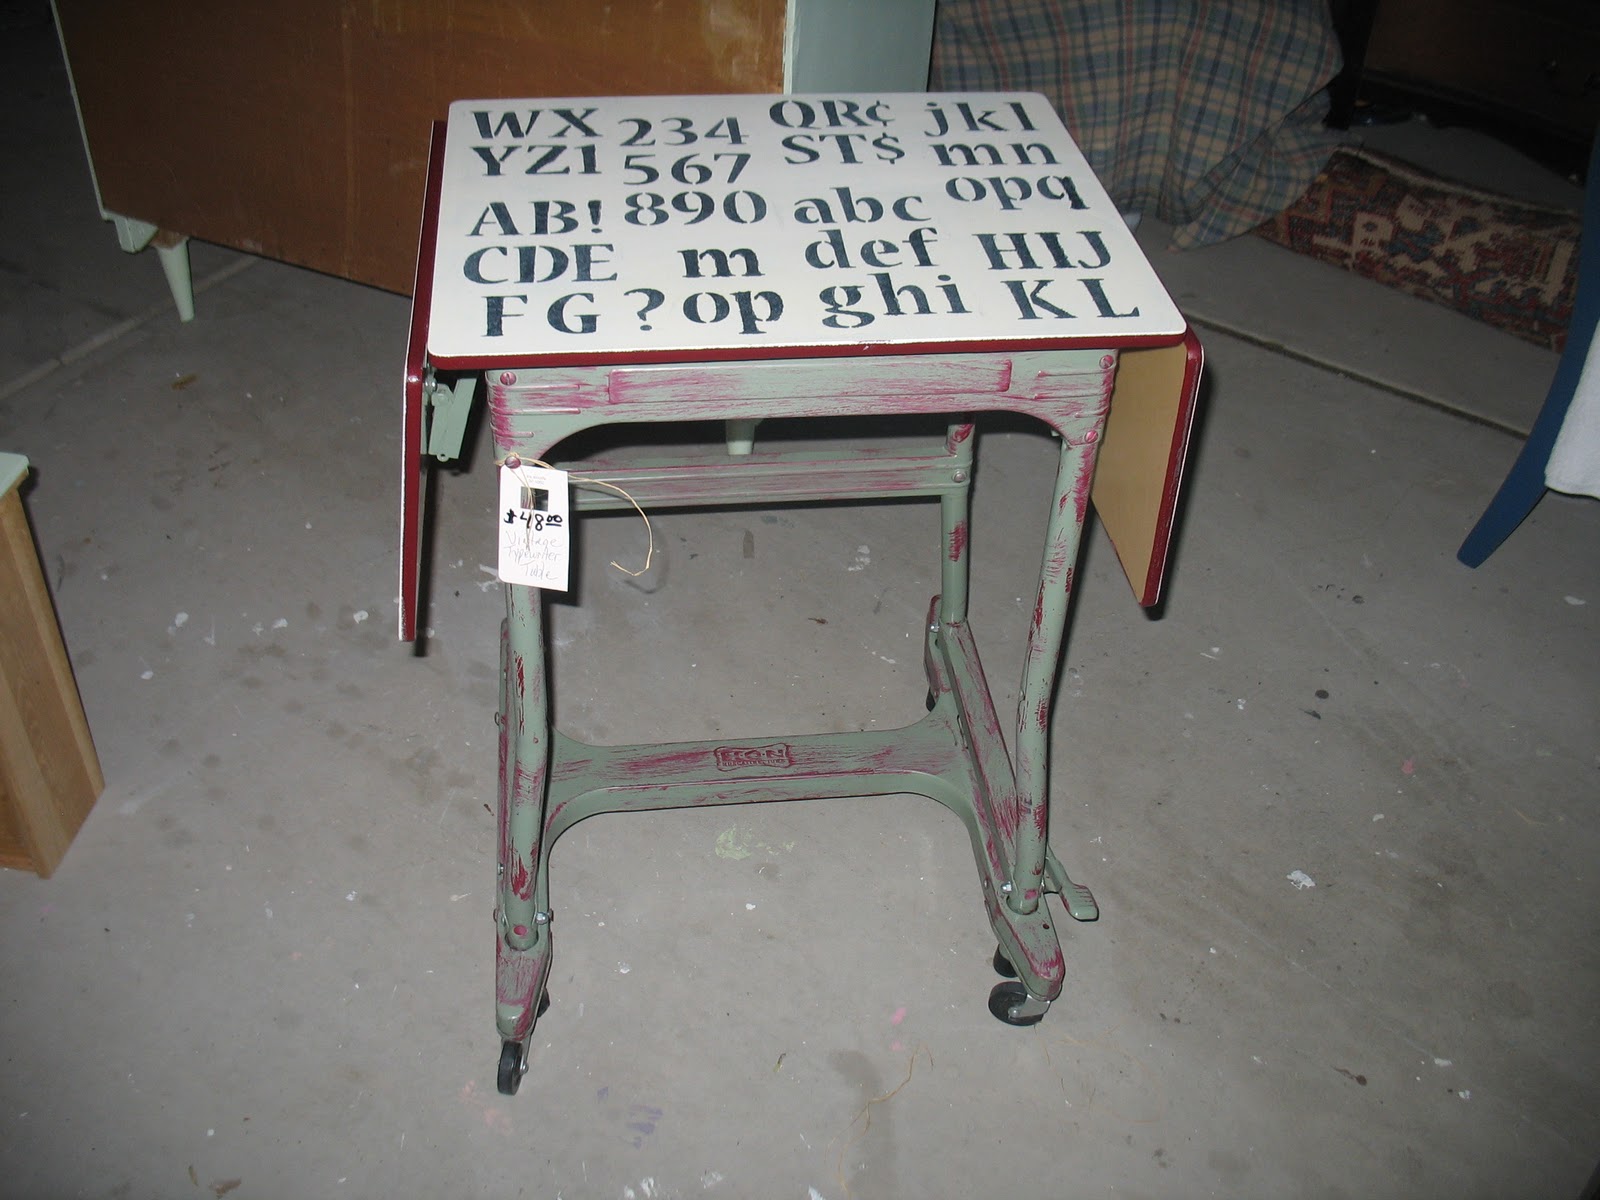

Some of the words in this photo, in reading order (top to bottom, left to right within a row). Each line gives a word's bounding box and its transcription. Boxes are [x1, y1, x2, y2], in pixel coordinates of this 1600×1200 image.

[470, 108, 603, 139] WX
[618, 116, 750, 146] 234
[781, 132, 906, 165] ST$
[929, 143, 1062, 166] mn
[623, 152, 752, 185] 567
[624, 190, 767, 226] 890
[794, 187, 932, 224] abc
[945, 176, 1090, 211] opq
[463, 244, 618, 284] CDE
[677, 248, 766, 278] m
[805, 227, 938, 269] def
[972, 231, 1111, 270] HIJ
[682, 291, 784, 334] op
[819, 273, 973, 328] ghi
